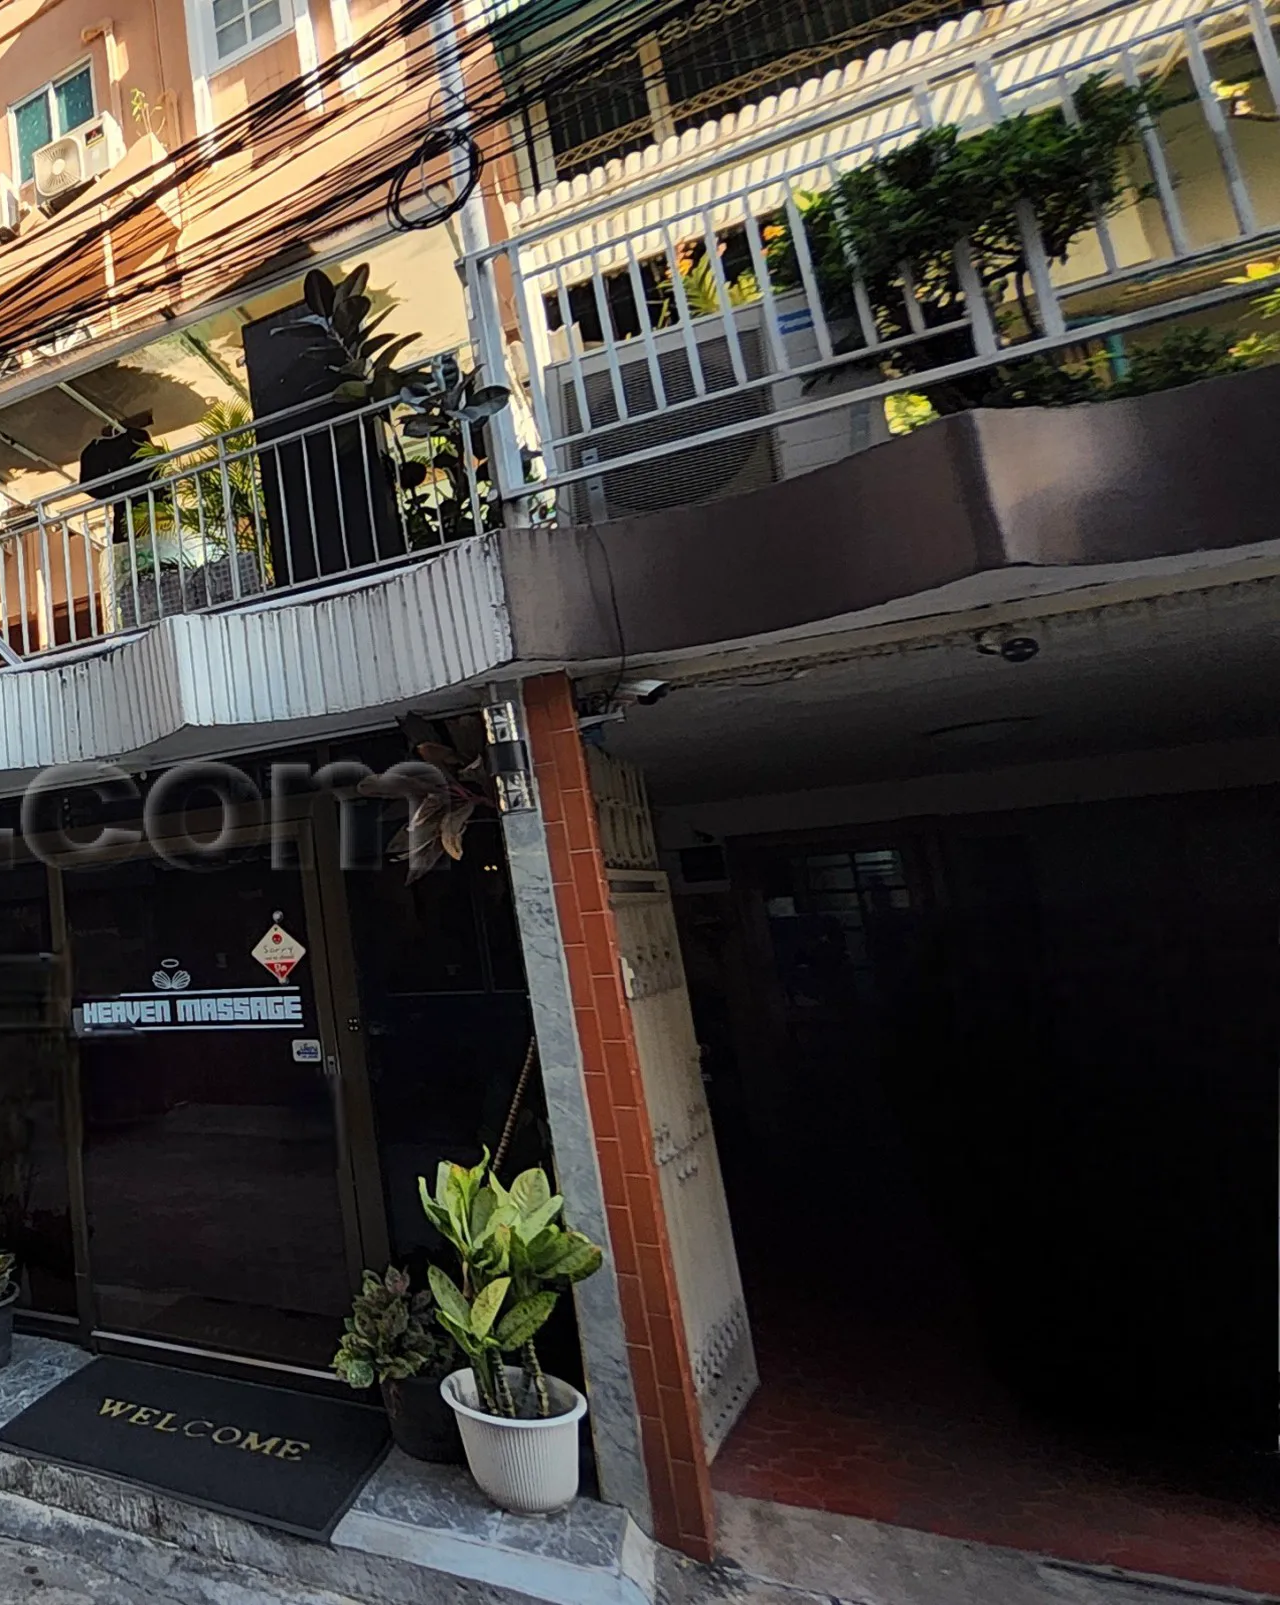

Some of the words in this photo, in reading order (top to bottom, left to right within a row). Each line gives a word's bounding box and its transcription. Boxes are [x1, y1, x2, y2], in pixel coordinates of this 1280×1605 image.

[83, 999, 171, 1025] HEAVEN
[176, 995, 303, 1023] MASSAGE
[98, 1397, 311, 1462] WELCOME
